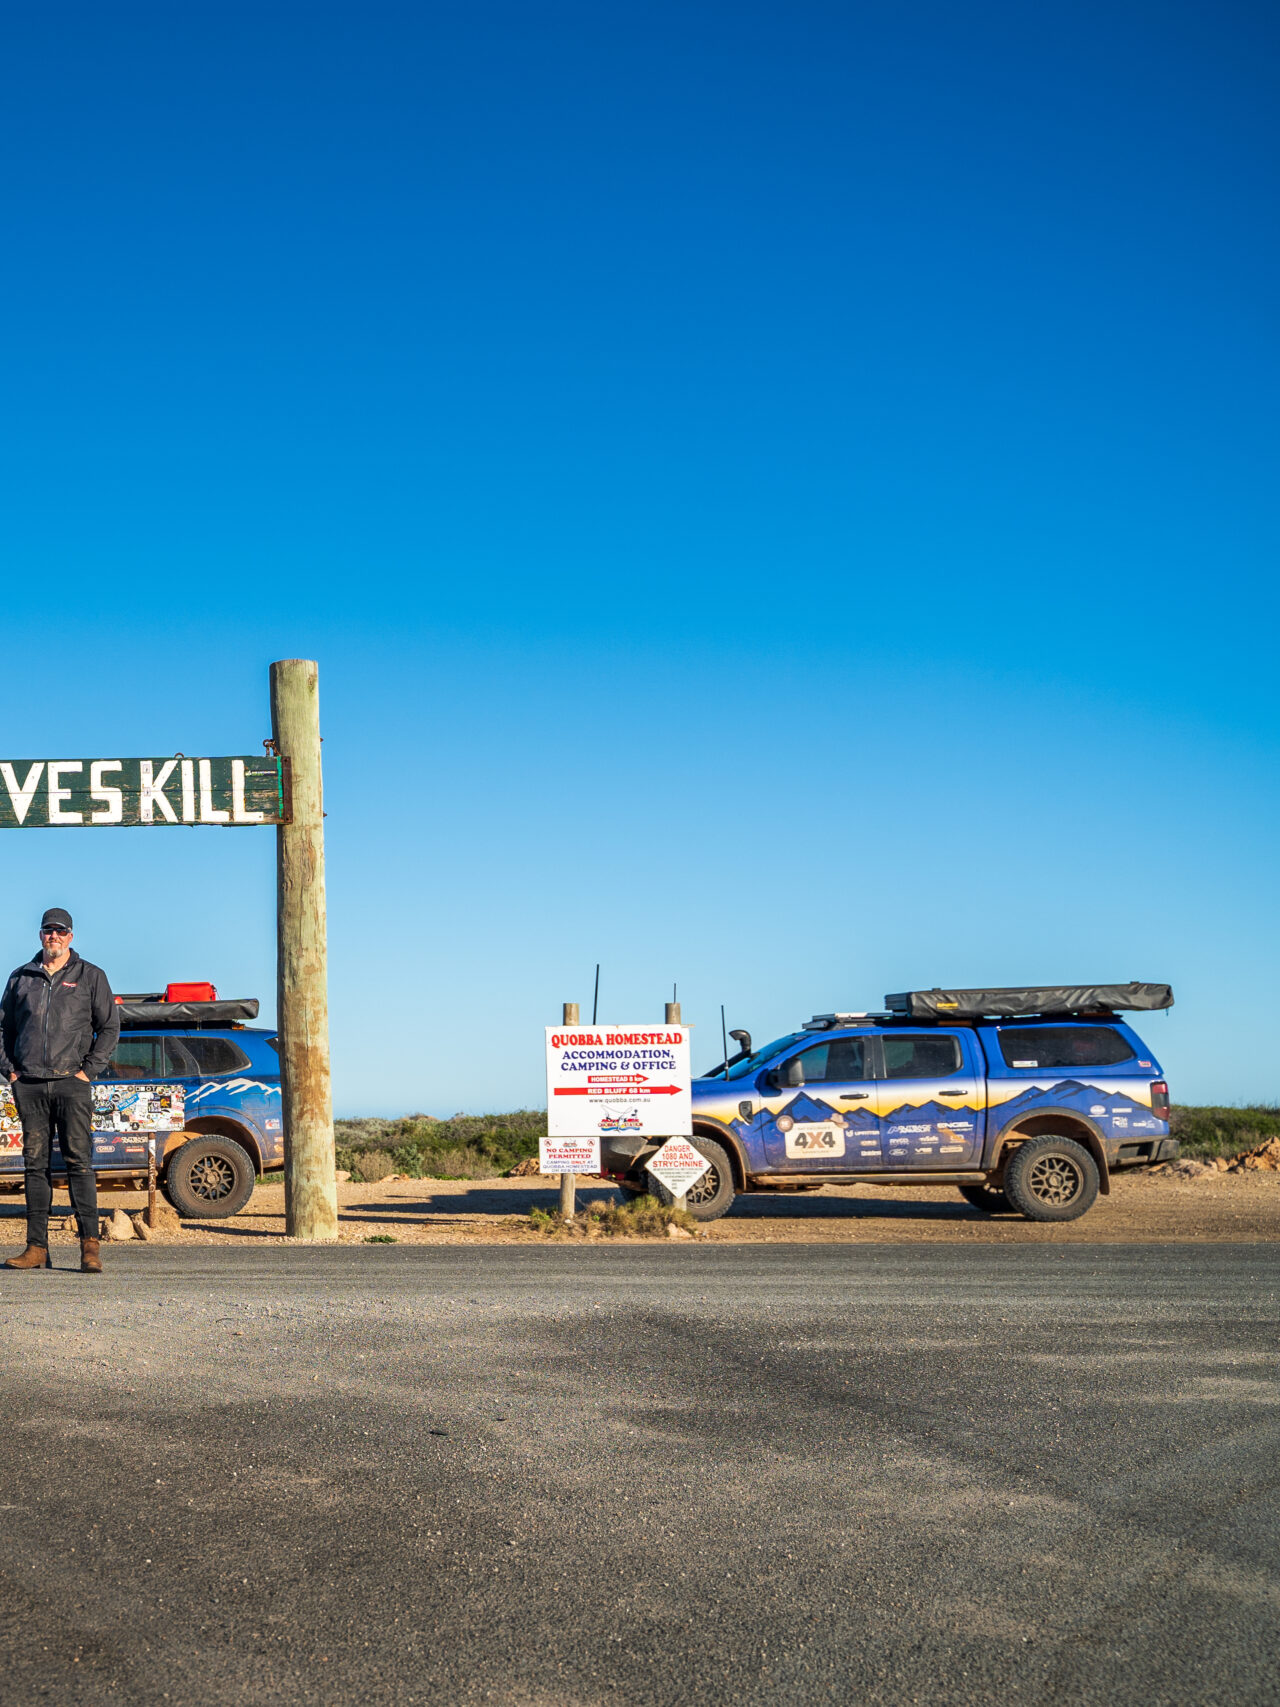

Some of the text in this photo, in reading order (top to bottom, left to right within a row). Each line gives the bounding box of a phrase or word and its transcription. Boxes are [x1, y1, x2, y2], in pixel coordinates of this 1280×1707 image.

[140, 759, 264, 822] KILL
[552, 1032, 682, 1048] QUOBBA HOMESTEAD
[562, 1050, 674, 1060] ACCOMMODATION,
[561, 1061, 676, 1071] CAMPING & OFFICE
[795, 1132, 835, 1148] 4X4
